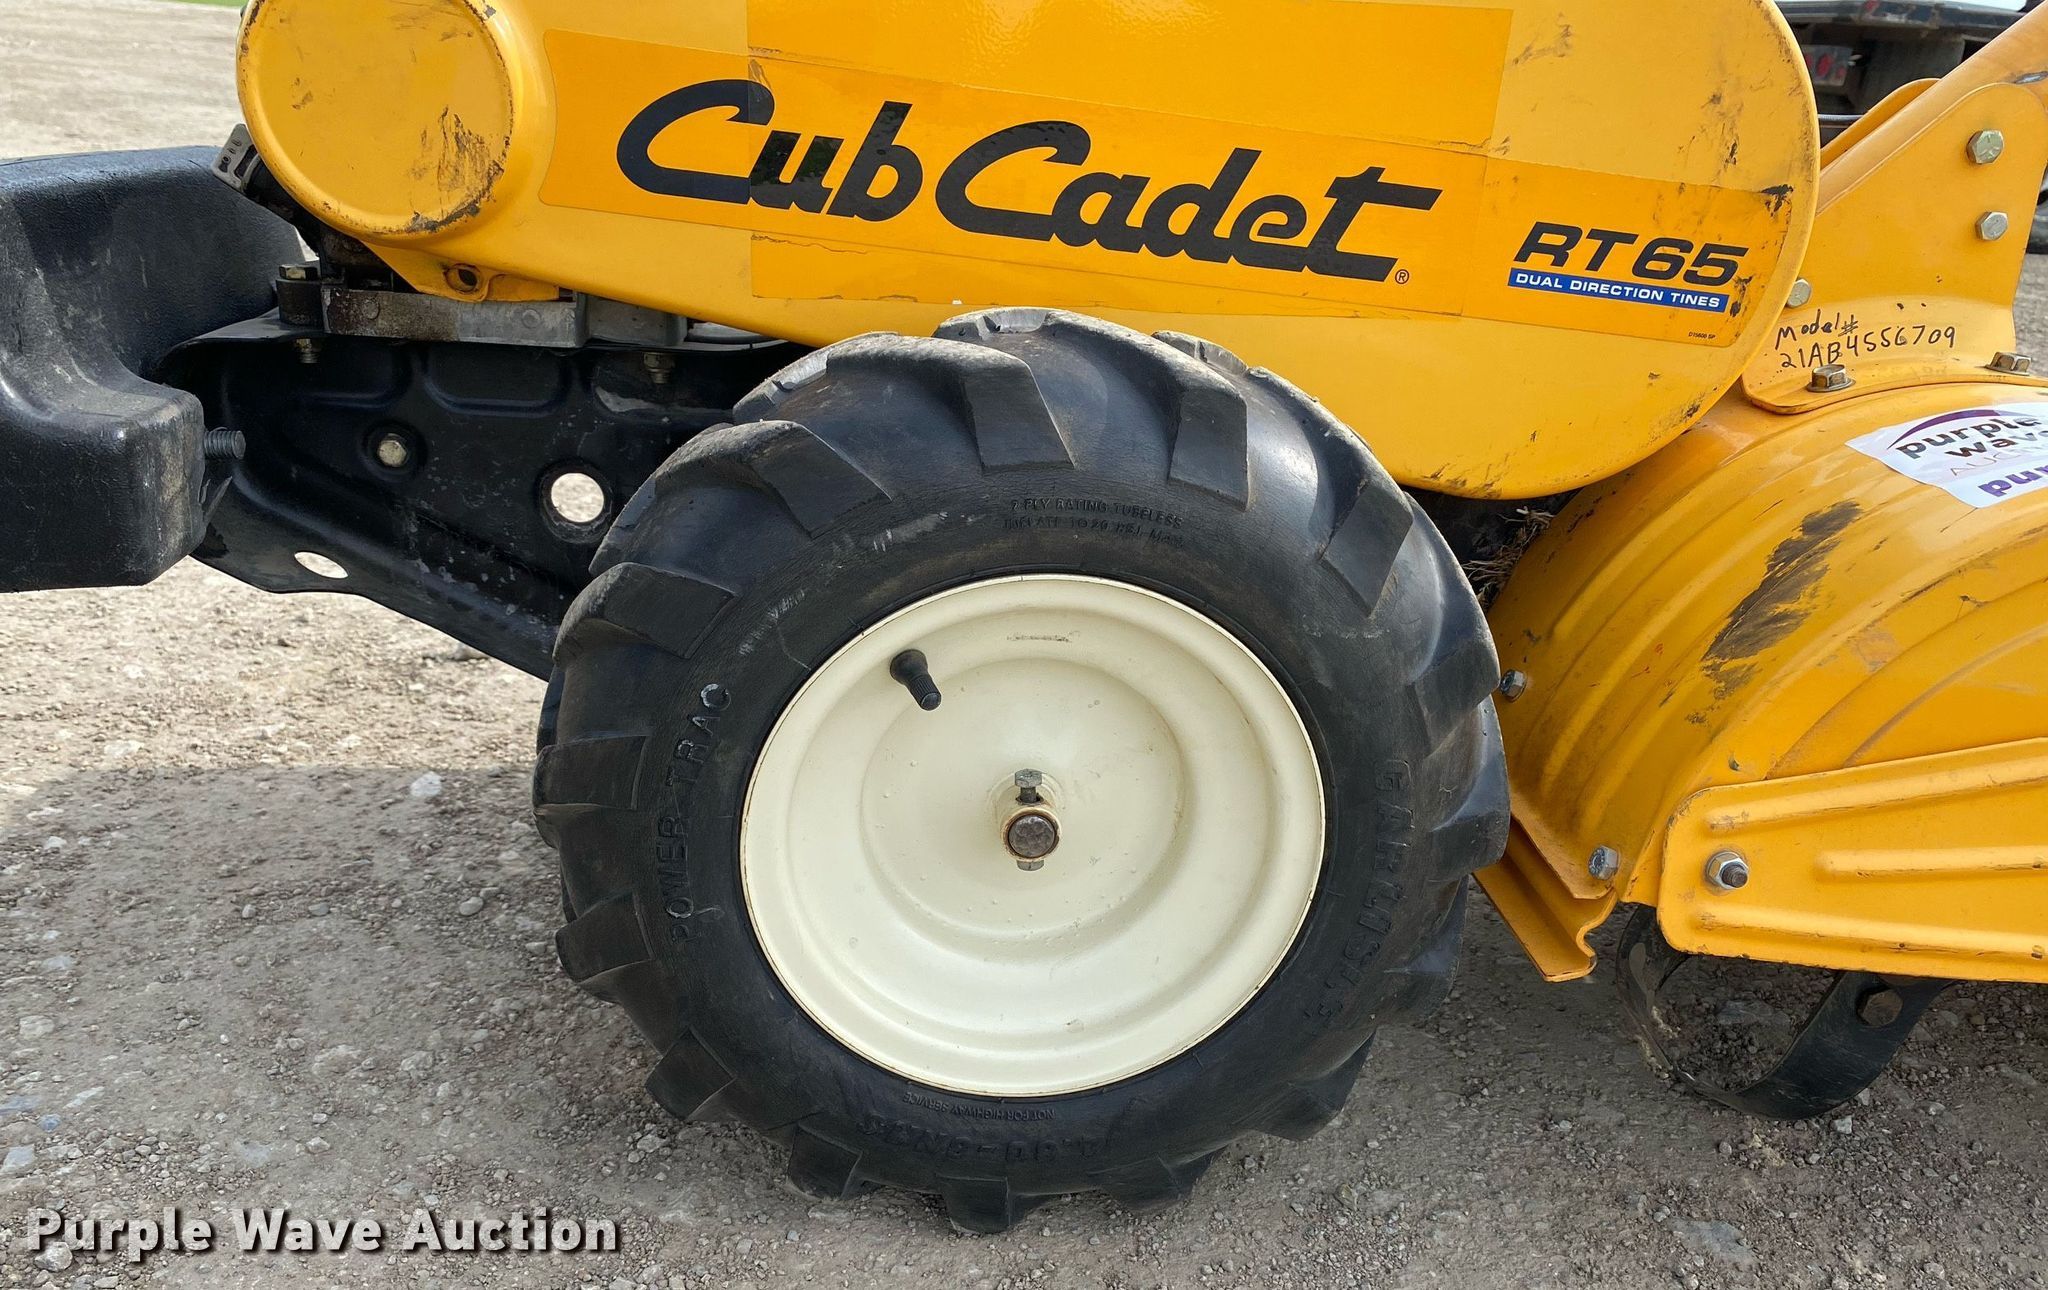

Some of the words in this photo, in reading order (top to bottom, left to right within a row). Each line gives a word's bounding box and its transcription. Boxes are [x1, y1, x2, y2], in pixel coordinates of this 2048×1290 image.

[616, 79, 923, 222] Cub
[935, 120, 1443, 282] Cadet
[1513, 221, 1639, 272] RT
[1631, 237, 1749, 287] 65
[1515, 273, 1563, 289] DUAL
[1569, 280, 1664, 301] DIRECTION
[1670, 292, 1720, 309] TINES
[1895, 416, 2043, 460] purple
[1055, 497, 1109, 514] RATING
[1114, 501, 1184, 529] TUBELESS
[665, 682, 732, 788] TRAC
[656, 815, 698, 944] POWER
[902, 1090, 949, 1115] SERVICE
[950, 1104, 1005, 1121] HIGHWAY
[1005, 1108, 1030, 1122] FOR
[1031, 1107, 1056, 1121] NOT
